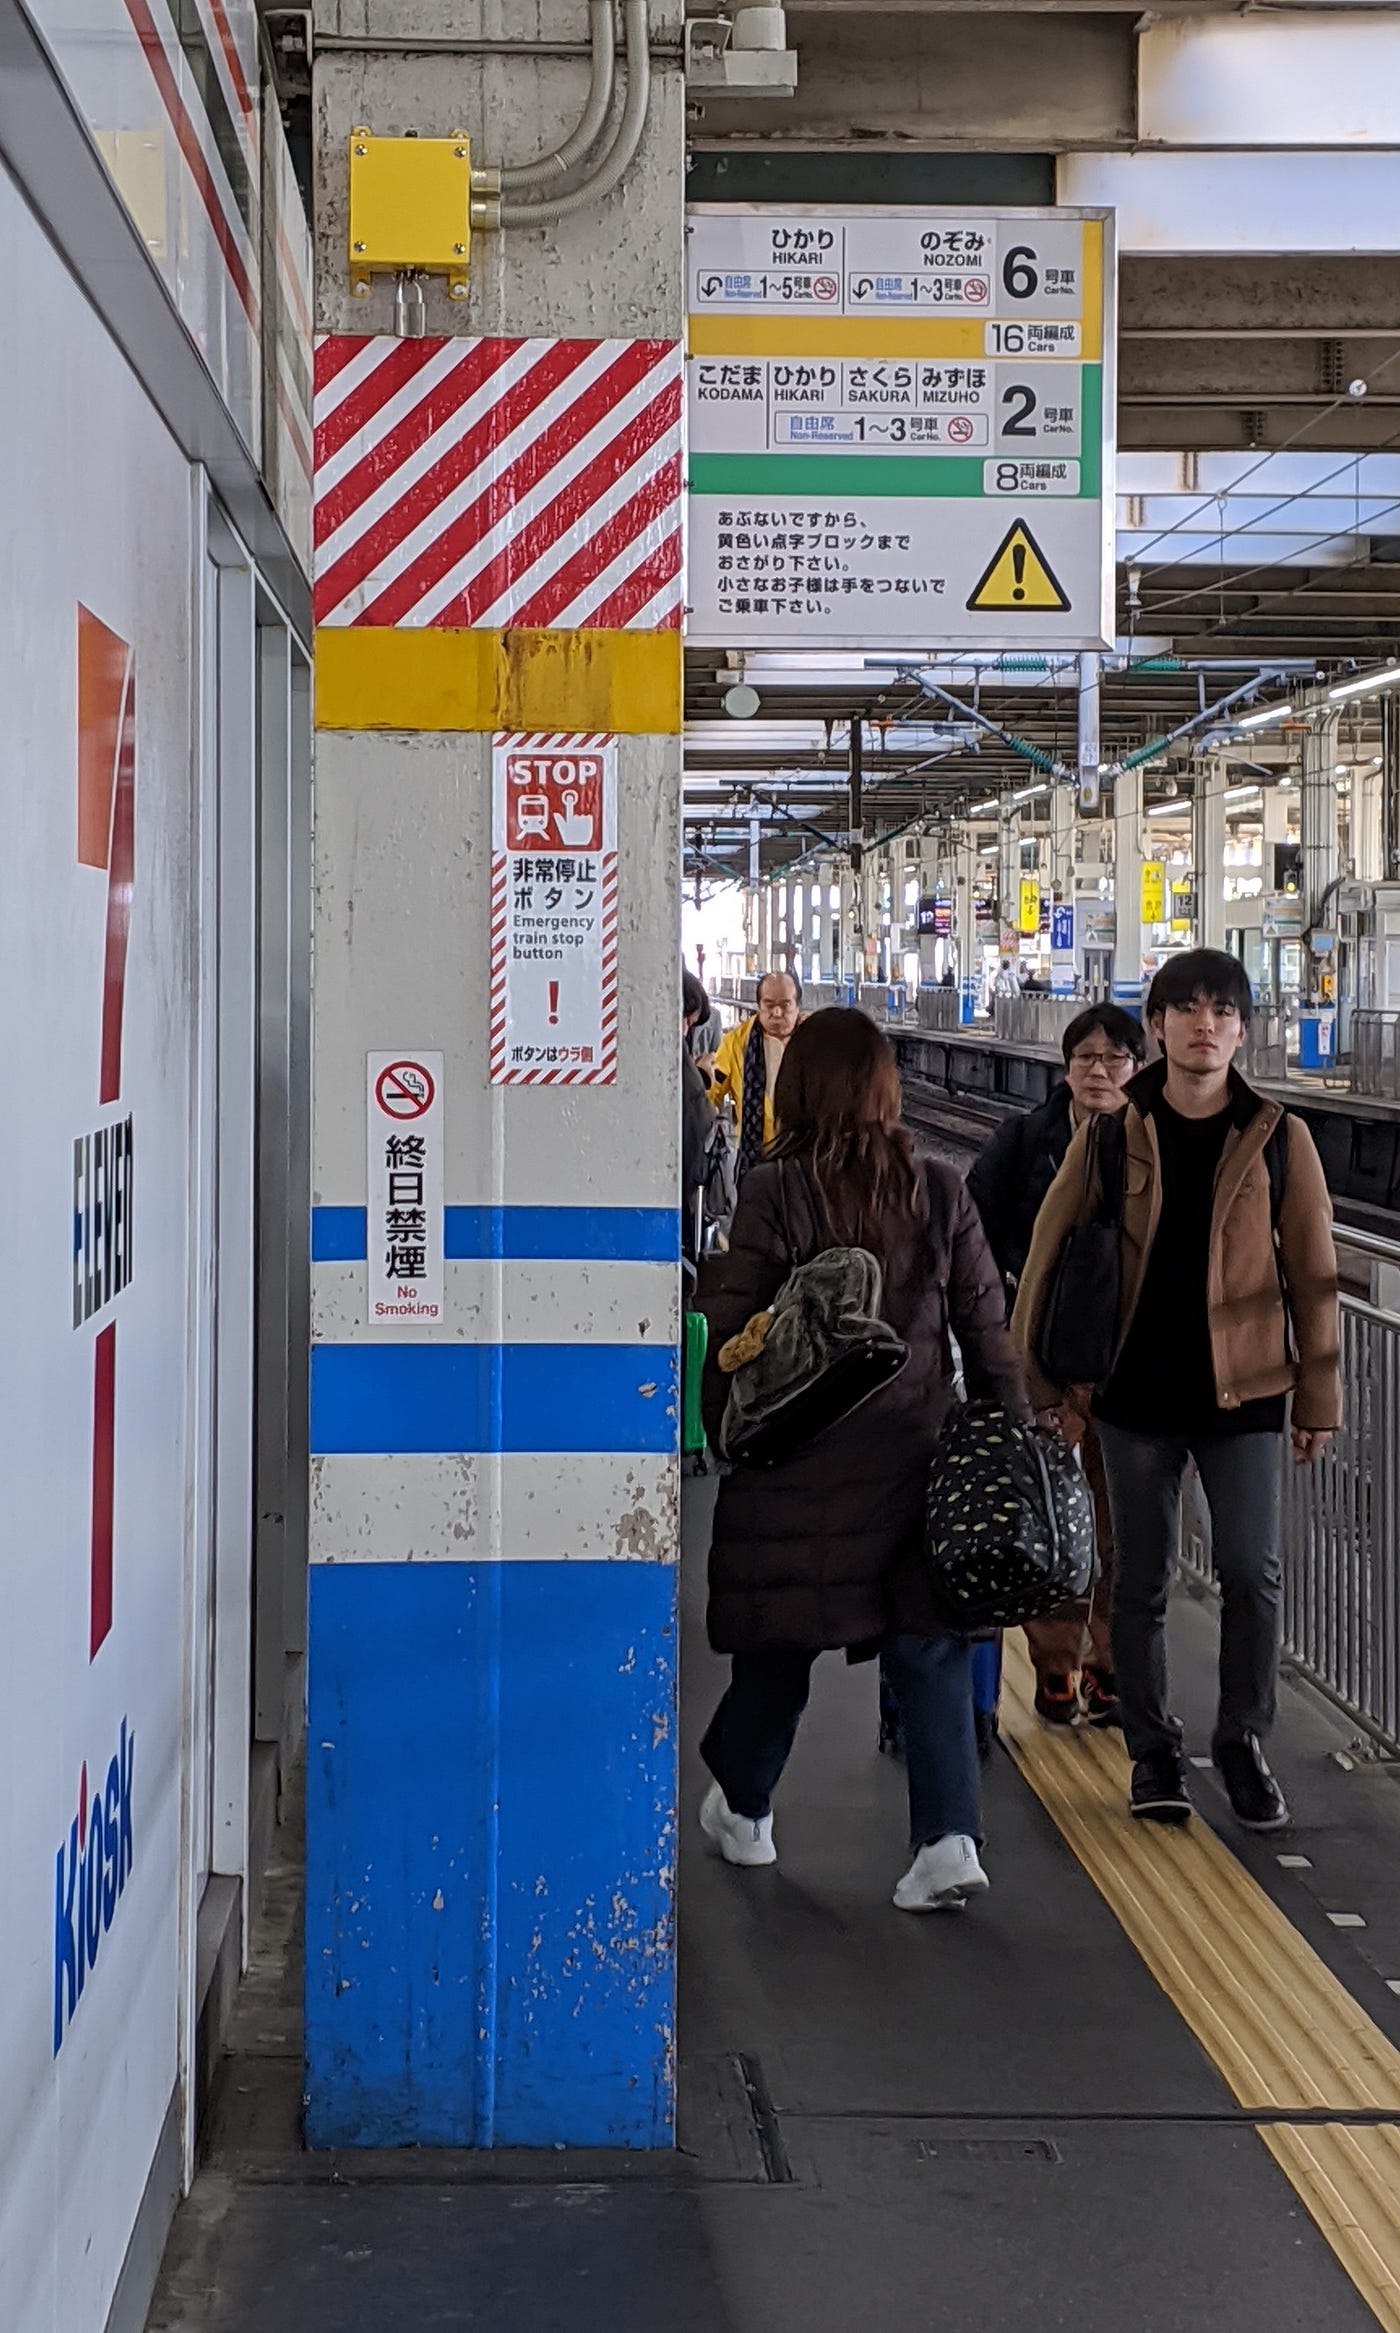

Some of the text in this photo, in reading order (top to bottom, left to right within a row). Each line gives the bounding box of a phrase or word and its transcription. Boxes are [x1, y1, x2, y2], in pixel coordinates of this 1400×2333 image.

[772, 228, 834, 249] ひかり
[920, 231, 986, 251] のぞみ
[772, 252, 823, 264] HIKARI
[923, 254, 982, 267] NOZOMI
[1002, 246, 1075, 299] 6 号車
[991, 324, 1076, 352] 16 両編成
[1028, 342, 1055, 352] Cars
[699, 365, 762, 385] こだま
[774, 366, 836, 387] ひかり
[849, 367, 912, 388] さくら
[922, 367, 986, 388] みずほ
[698, 388, 764, 401] KODAMA
[774, 389, 825, 401] HIKARI
[848, 390, 911, 403] SAKURA
[923, 391, 980, 404] MIZUHO
[1001, 385, 1074, 437] 2 号車
[790, 416, 835, 431] 自由席
[910, 417, 938, 432] 号車
[790, 431, 854, 441] Non-Reserved
[996, 463, 1067, 491] 8 両編成
[1020, 480, 1047, 491] Cars
[717, 511, 867, 528] あぶないですから、
[717, 533, 911, 550] 黄色い点字ブロックまで
[717, 555, 849, 572] おさがり下さい。
[717, 577, 945, 593] 小さなお子様は手をつないで
[718, 599, 831, 614] ご乗車下さい。
[513, 760, 597, 785] STOP
[513, 858, 597, 883] 非常停止
[513, 915, 595, 931] Emergency
[513, 931, 584, 948] train stop
[513, 947, 563, 960] button
[386, 1134, 427, 1279] 終日禁煙
[397, 1286, 418, 1298] No
[375, 1302, 439, 1317] Smoking
